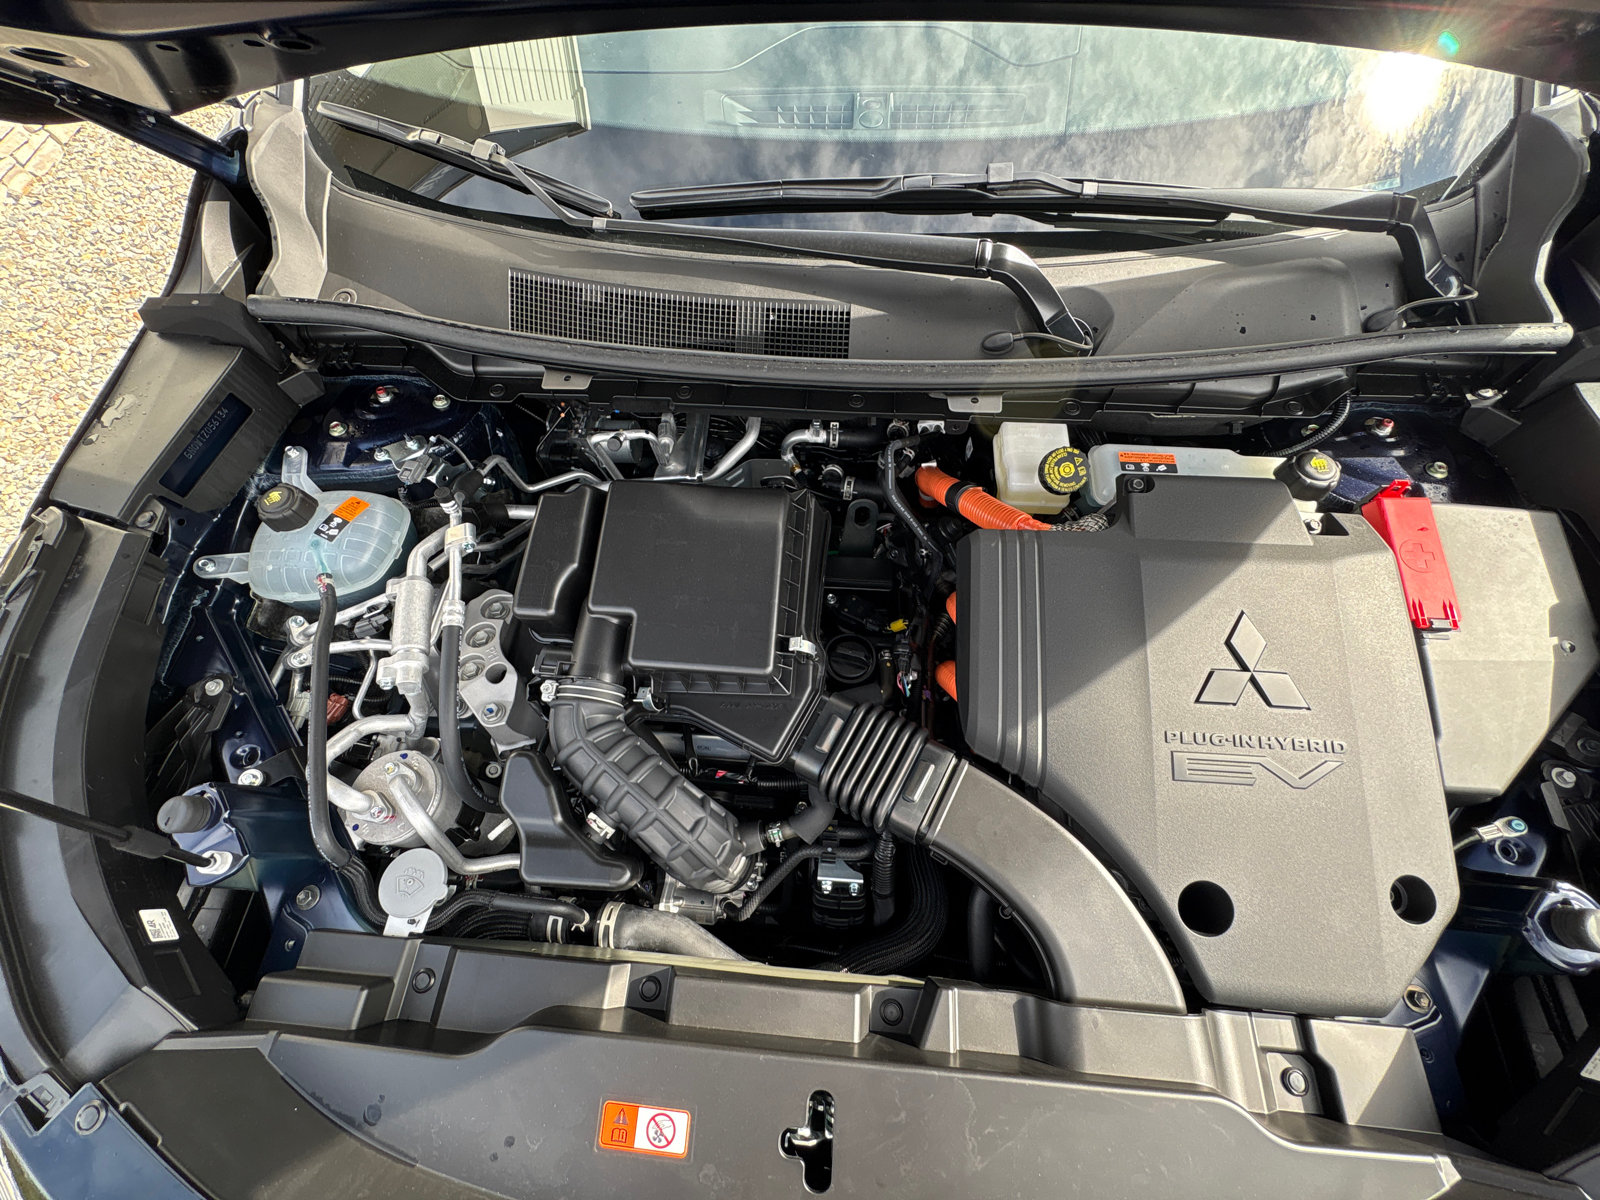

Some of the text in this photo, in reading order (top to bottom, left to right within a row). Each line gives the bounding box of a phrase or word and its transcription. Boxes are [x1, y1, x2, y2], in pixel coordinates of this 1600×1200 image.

[1164, 730, 1347, 754] PLUG-IN HYBRID
[1170, 750, 1346, 790] EV
